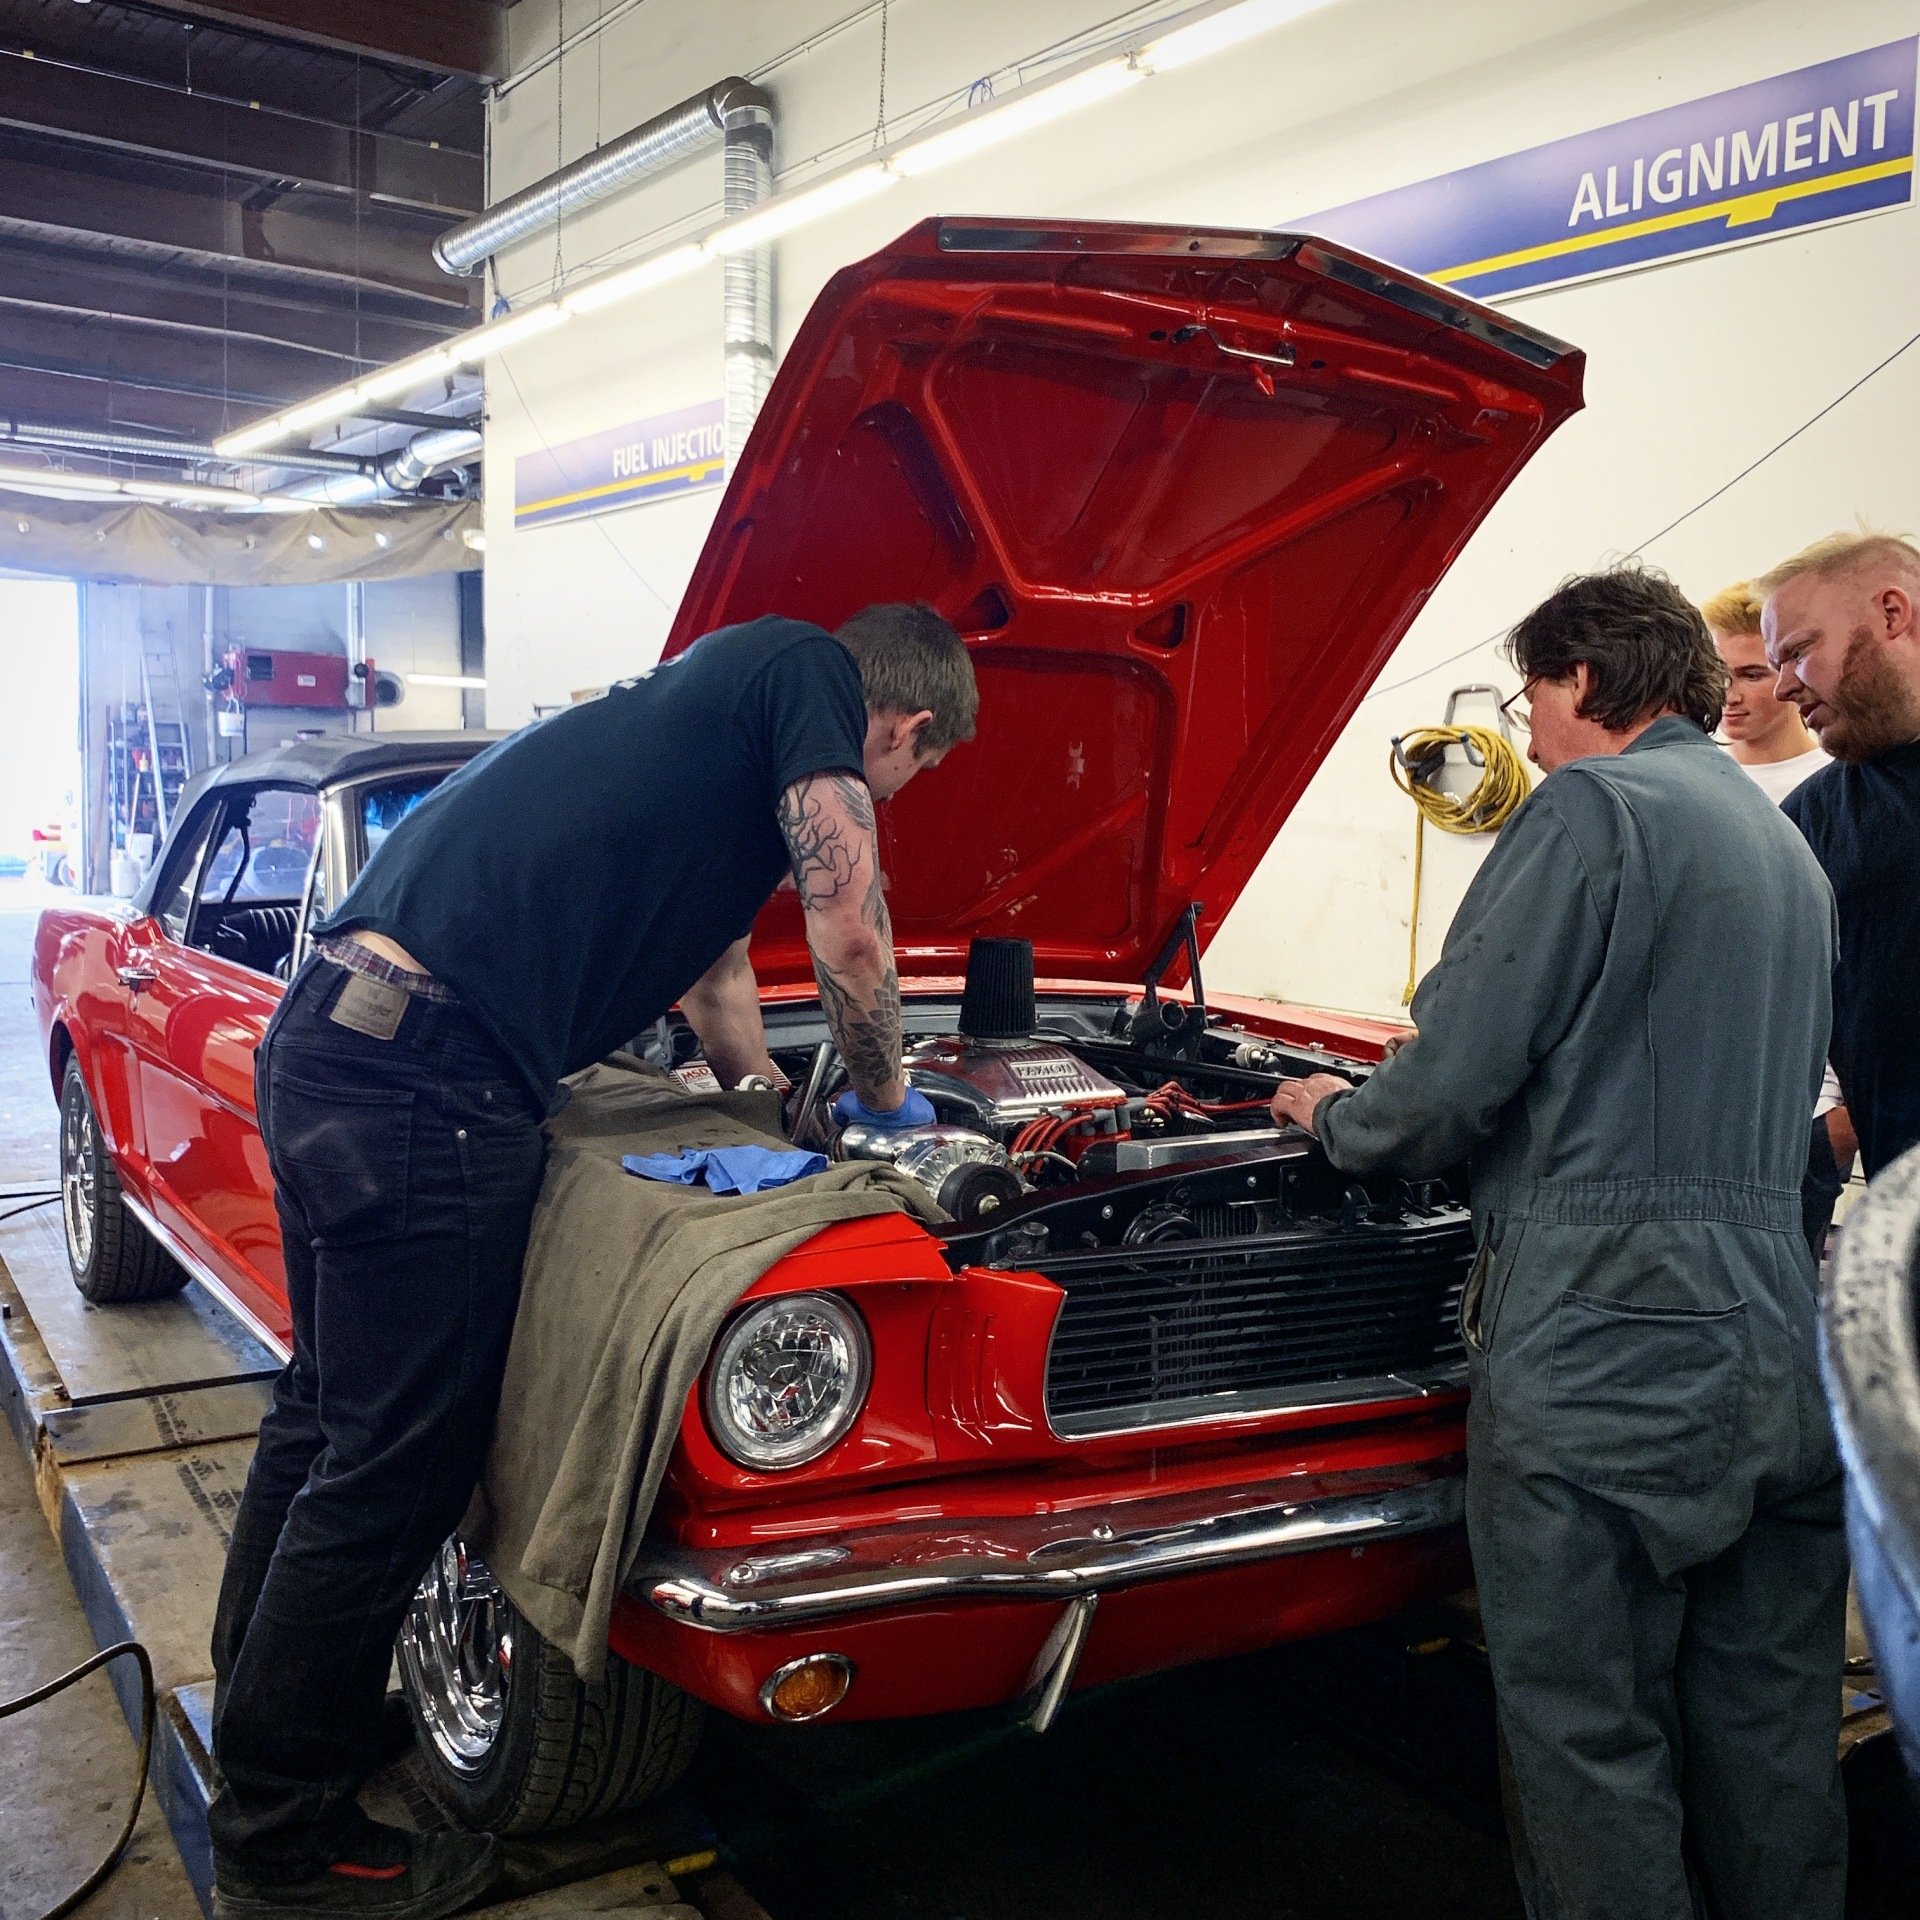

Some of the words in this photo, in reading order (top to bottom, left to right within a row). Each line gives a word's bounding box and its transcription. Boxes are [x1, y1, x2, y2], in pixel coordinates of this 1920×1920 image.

[1567, 88, 1899, 227] ALIGNMENT
[612, 441, 650, 479] FUEL
[651, 421, 725, 469] INJECTIO
[681, 1067, 709, 1084] MSD
